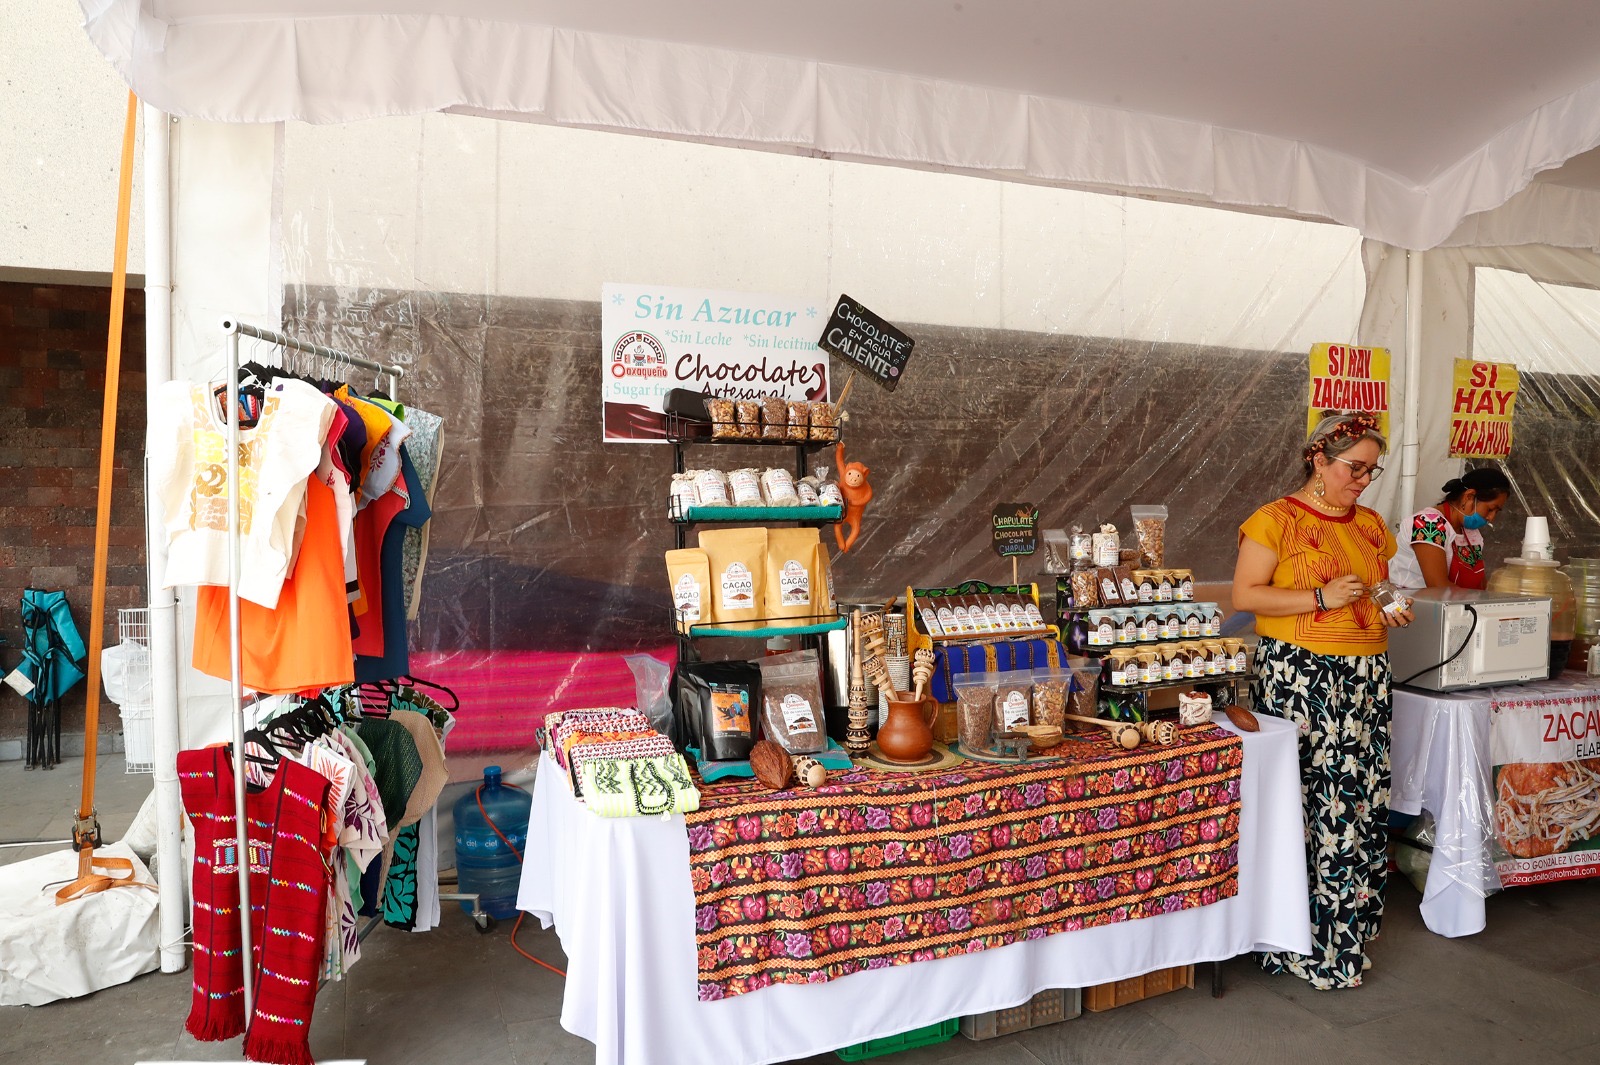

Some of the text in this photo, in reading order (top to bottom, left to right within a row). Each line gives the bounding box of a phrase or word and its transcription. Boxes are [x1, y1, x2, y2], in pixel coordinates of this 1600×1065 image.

[635, 294, 796, 327] Sin Azucar
[837, 303, 905, 354] CHOCOLATE
[695, 331, 732, 346] Leche
[773, 335, 819, 351] lecitina
[848, 328, 892, 361] EN AGUA
[827, 328, 892, 379] CALIENTE
[1328, 345, 1372, 379] SI HAY
[611, 363, 668, 379] Oaxaqueño
[675, 353, 815, 385] Chocolate
[1470, 362, 1498, 389] SI
[613, 382, 650, 399] Sugar
[1312, 377, 1388, 411] ZACAHUIL
[1453, 387, 1515, 416] HAY
[1450, 419, 1511, 455] ZACAHUIL
[992, 514, 1034, 527] CHAPULATE
[994, 530, 1033, 540] CHOCOLATE
[999, 538, 1036, 554] CHAPULIN
[722, 581, 752, 589] CACAO
[781, 577, 808, 586] CACAO
[675, 592, 699, 600] CACAO
[485, 839, 498, 847] ciel
